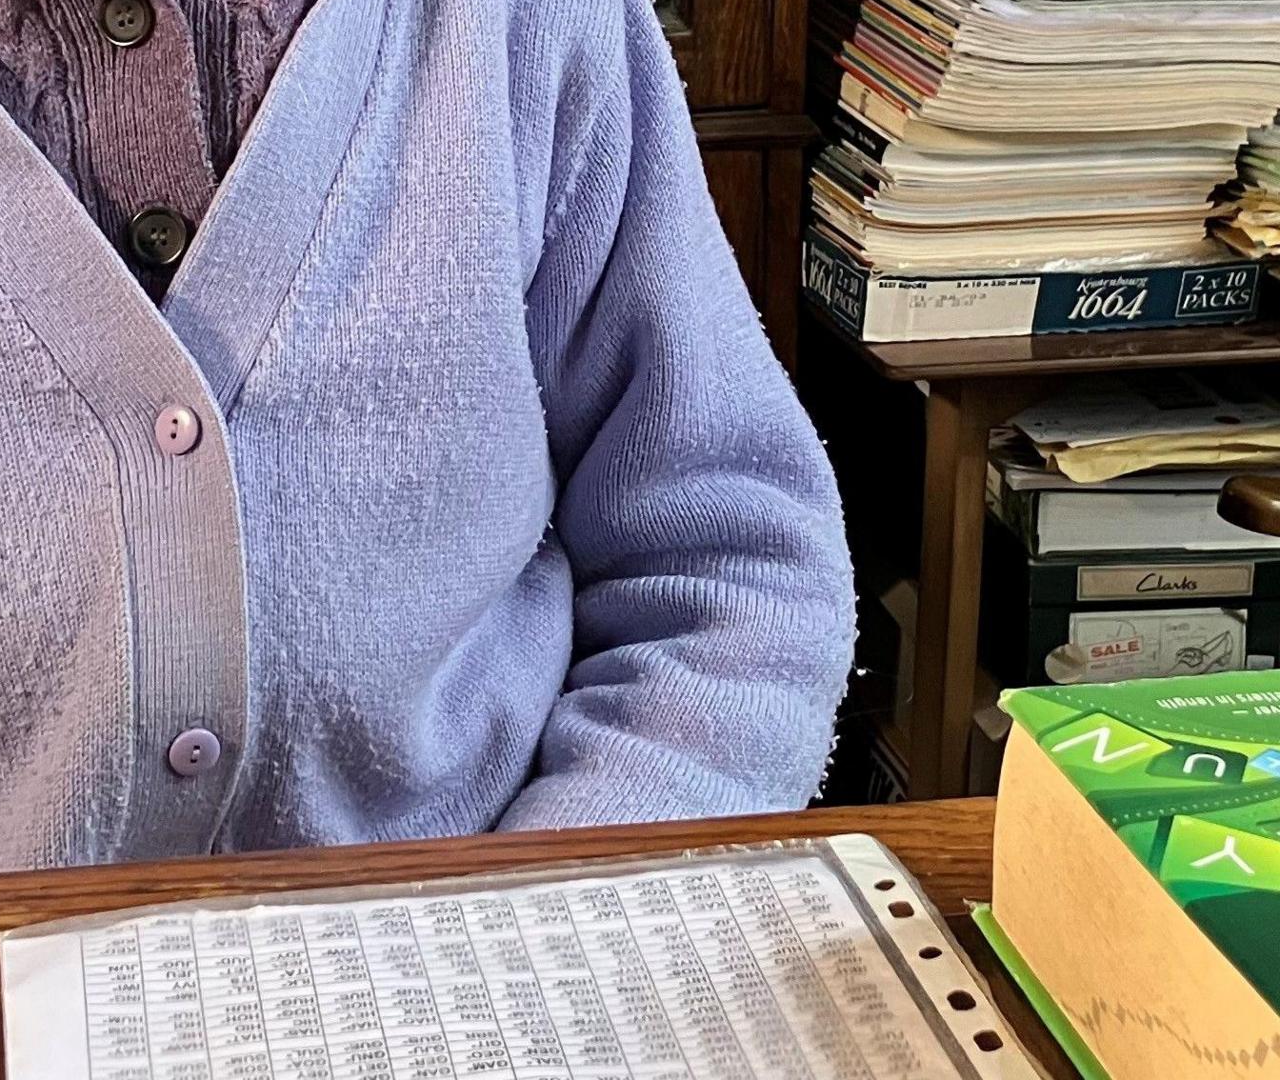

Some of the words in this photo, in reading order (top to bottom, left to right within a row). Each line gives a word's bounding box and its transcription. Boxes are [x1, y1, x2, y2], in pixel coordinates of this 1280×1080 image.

[1068, 286, 1147, 321] 1664
[1192, 273, 1206, 289] 2
[1209, 276, 1221, 288] x
[1224, 271, 1246, 288] 10
[1182, 287, 1253, 311] PACKS
[1135, 572, 1200, 595] Clarks
[1090, 640, 1141, 659] SALE
[1156, 694, 1213, 711] length
[1215, 692, 1234, 706] in
